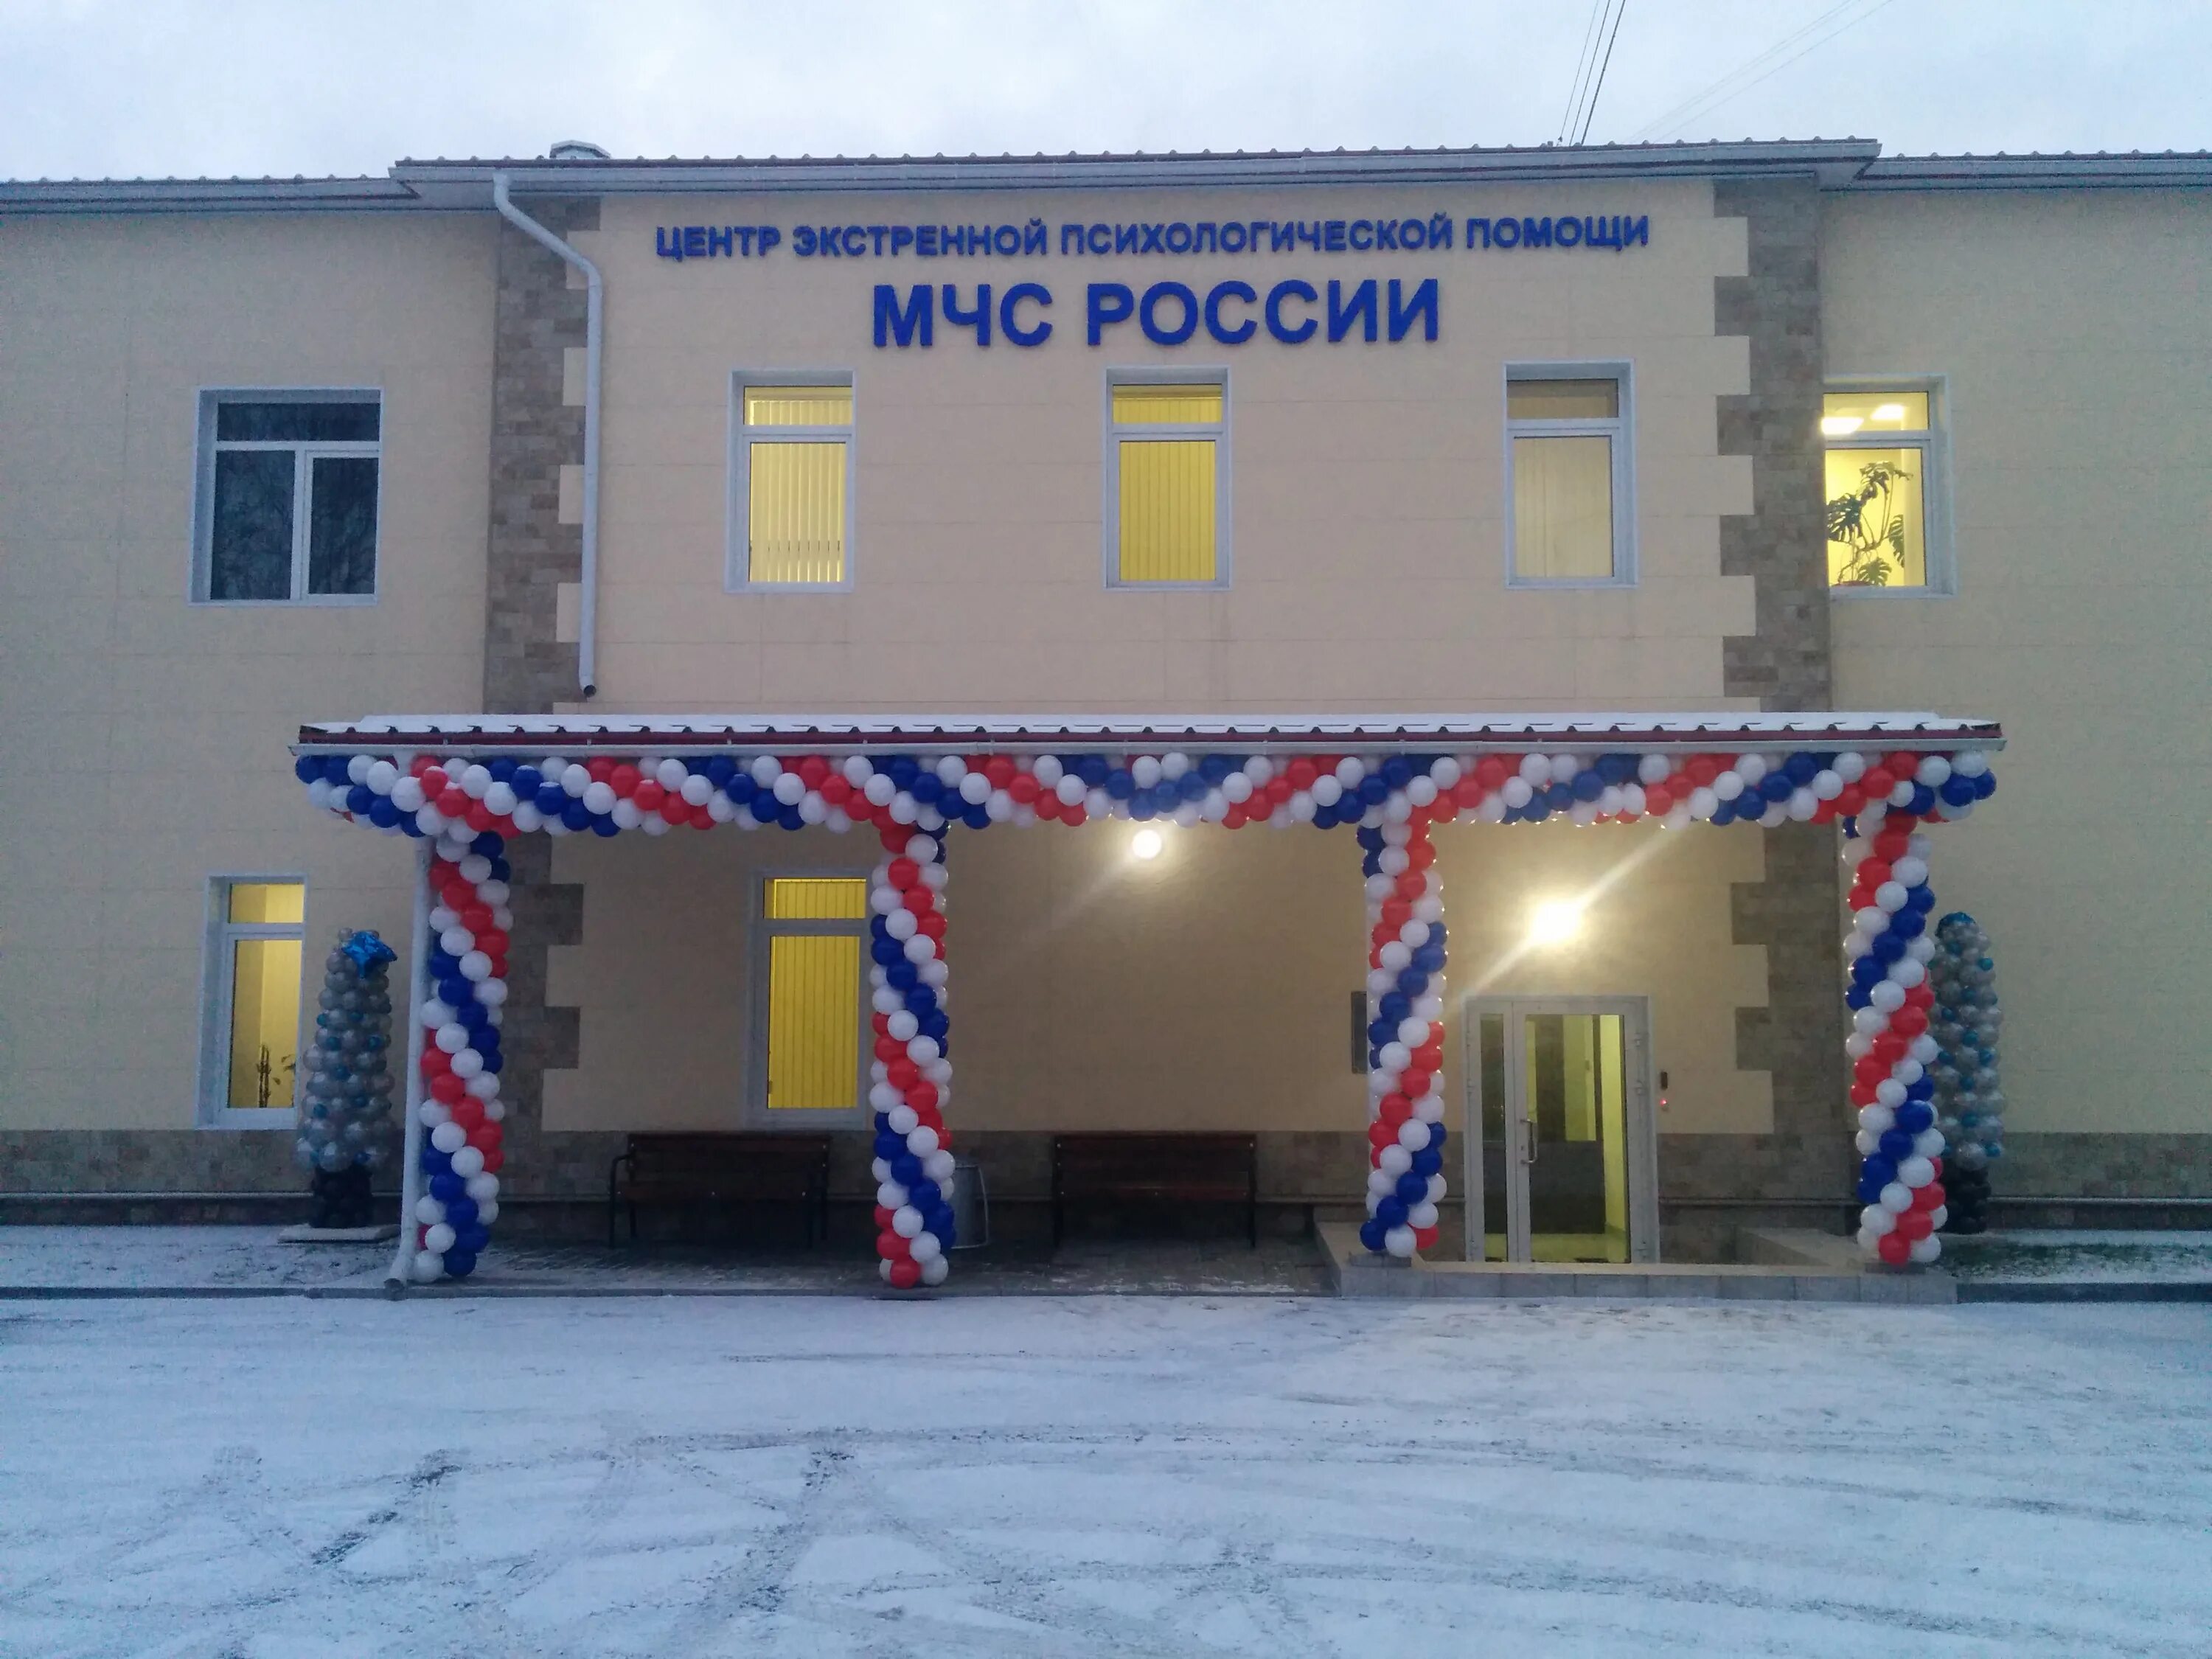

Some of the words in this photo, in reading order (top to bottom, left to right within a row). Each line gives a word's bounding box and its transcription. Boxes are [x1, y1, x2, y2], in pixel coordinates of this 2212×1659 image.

[655, 225, 782, 261] ЦЕНТР
[792, 218, 1048, 257] ЭКСТРЕННОЙ
[1060, 212, 1455, 255] ПСИХОЛОГИЧЕСКОЙ
[1466, 215, 1649, 251] ПОМОЩИ
[872, 282, 1054, 347] МЧС
[1086, 278, 1439, 346] РОССИИ
